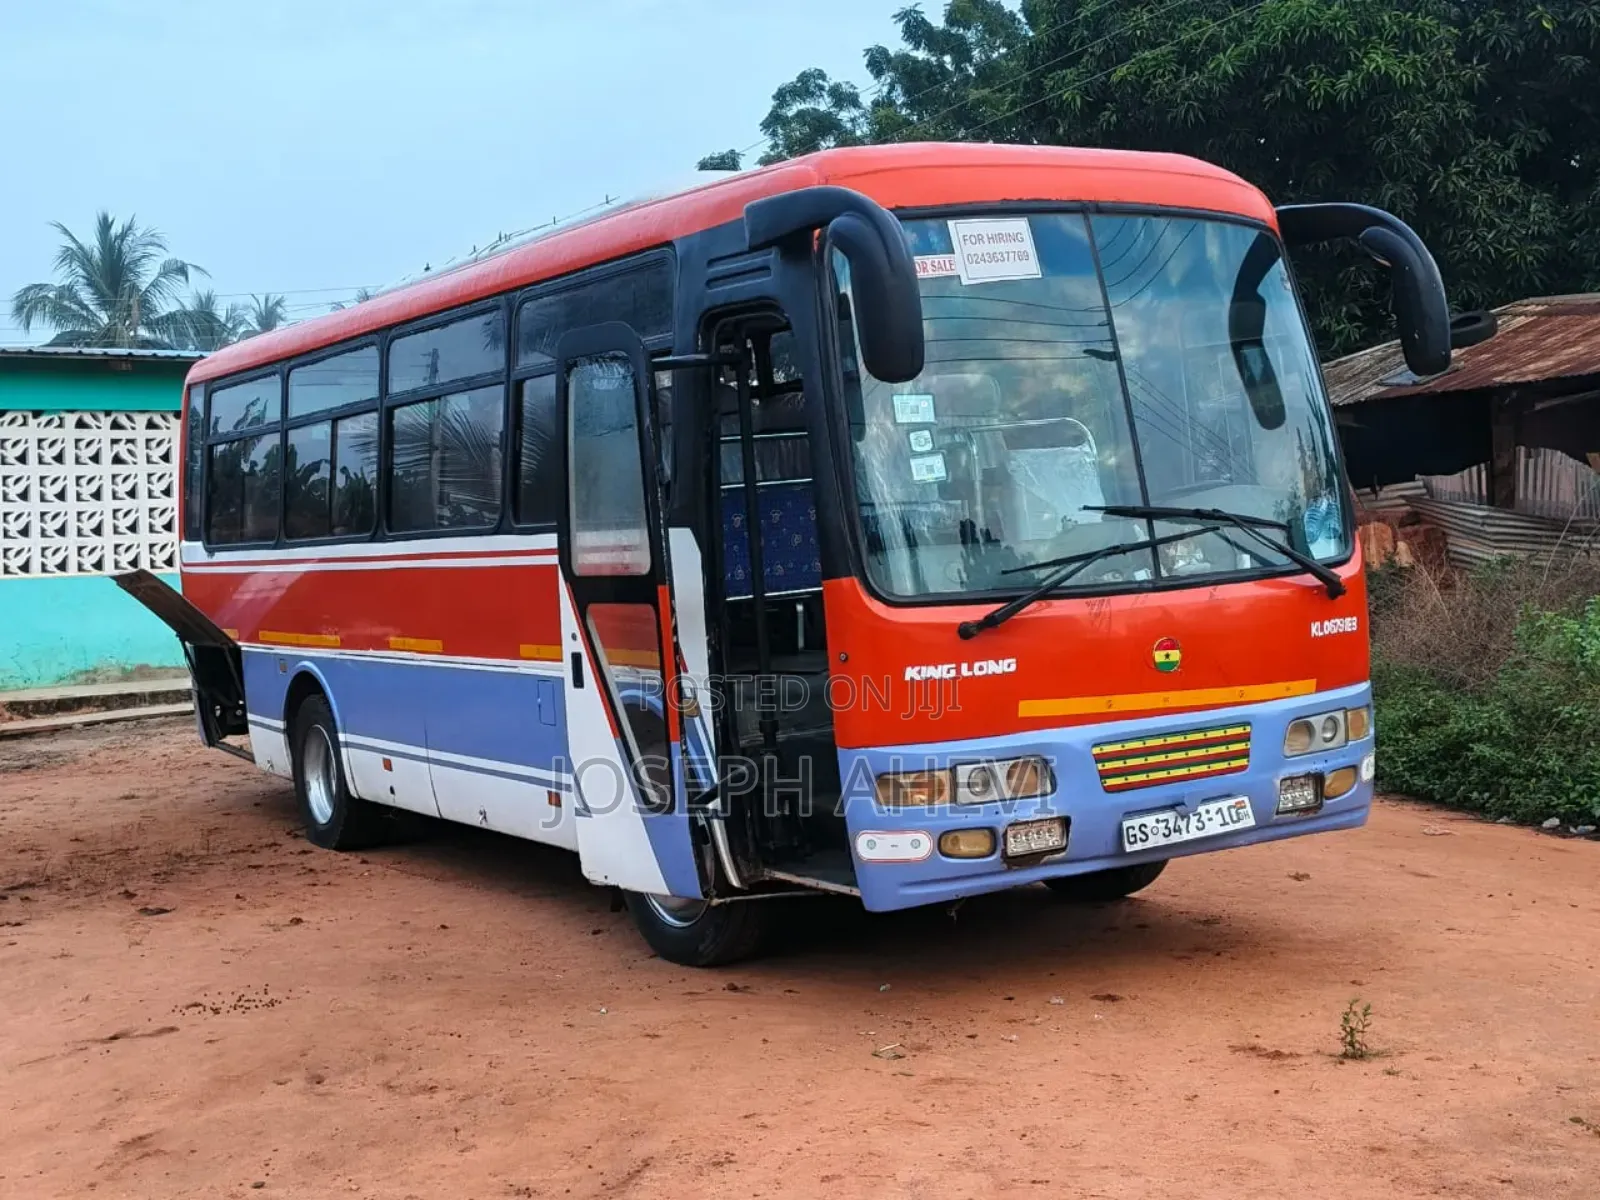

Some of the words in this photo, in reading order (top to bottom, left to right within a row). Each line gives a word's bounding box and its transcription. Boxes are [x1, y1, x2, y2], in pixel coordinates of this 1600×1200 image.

[962, 234, 985, 246] FOR
[987, 231, 1025, 244] HIRING
[966, 250, 1029, 264] 0243637769
[914, 260, 929, 274] OR
[931, 259, 955, 273] SALE
[904, 664, 956, 681] KING
[960, 658, 1017, 676] LONG
[1125, 823, 1149, 846] GS
